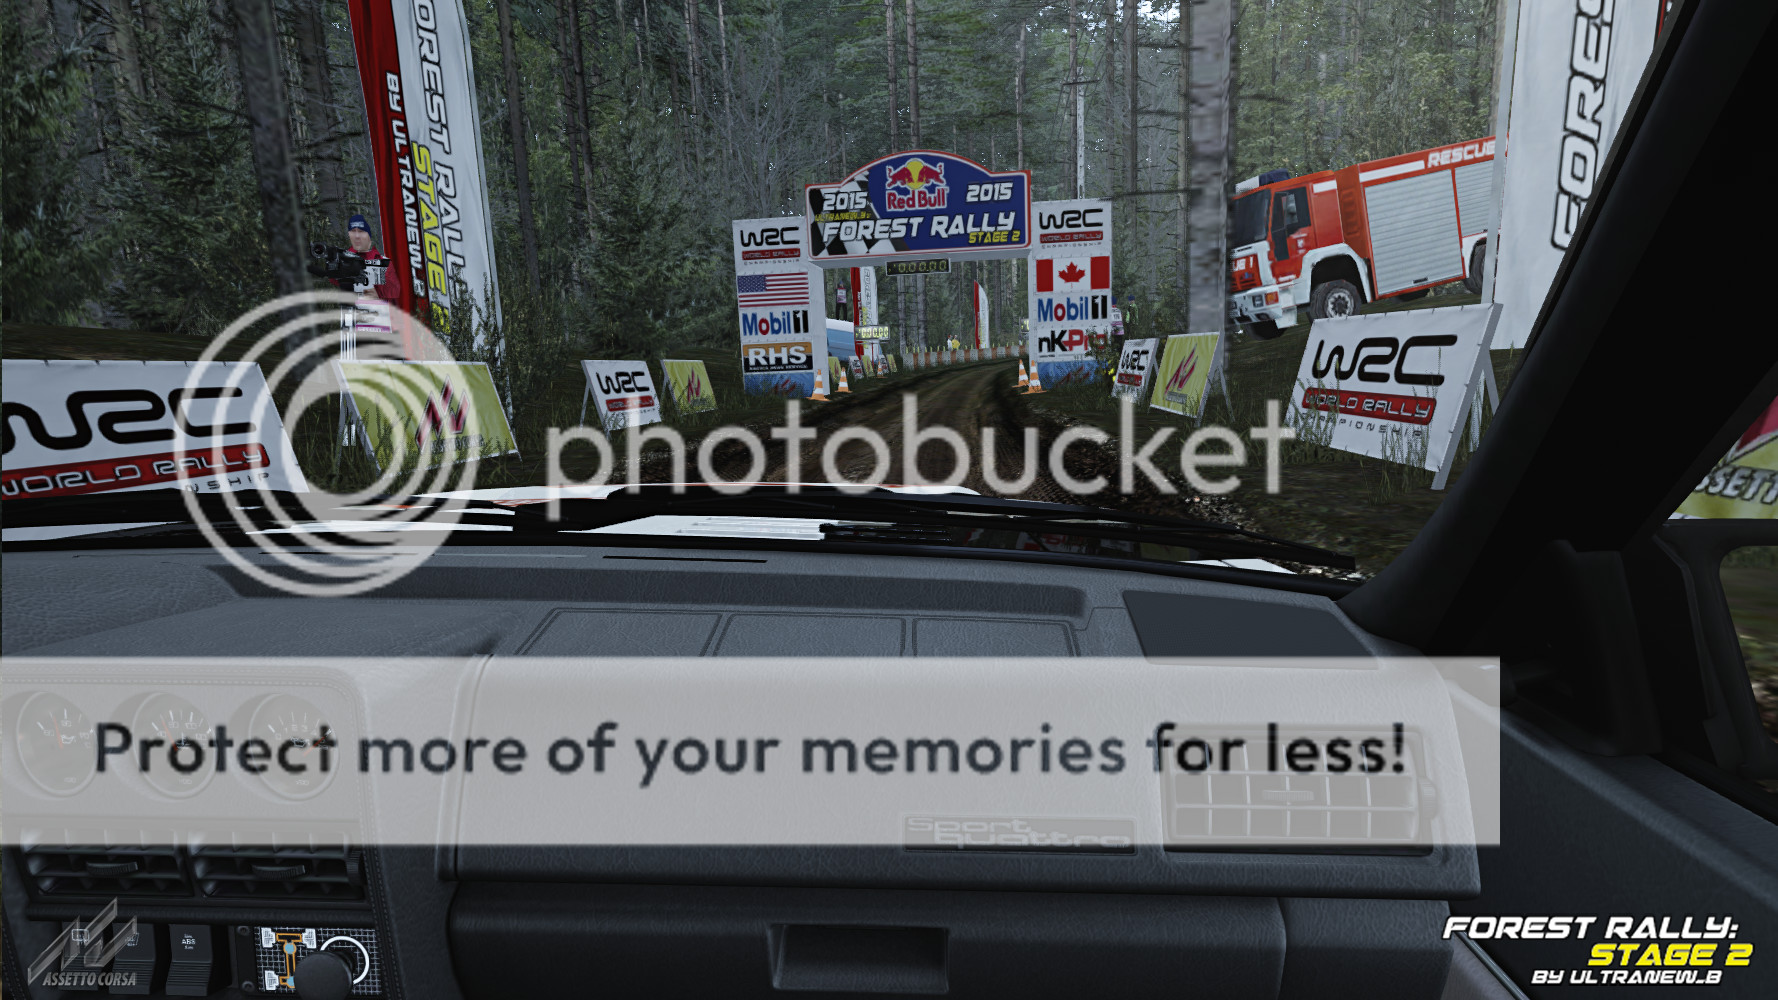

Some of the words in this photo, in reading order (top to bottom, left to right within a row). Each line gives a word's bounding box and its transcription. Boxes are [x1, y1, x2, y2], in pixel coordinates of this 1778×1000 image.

[386, 72, 402, 112] BY
[822, 191, 868, 211] 2015
[887, 191, 916, 211] Red
[917, 187, 947, 208] Bull
[966, 182, 1013, 202] 2015
[411, 141, 447, 297] STAGE
[434, 160, 469, 299] RALL
[823, 216, 924, 243] FOREST
[930, 211, 1016, 239] RALLY
[1039, 208, 1103, 230] WRC
[740, 226, 800, 247] WRC
[968, 232, 1009, 244] STAGE
[1012, 230, 1020, 242] 2
[1037, 296, 1089, 322] Mobil
[742, 311, 791, 336] Mobil
[748, 345, 807, 366] RHS
[1312, 334, 1458, 386] WRC
[595, 371, 650, 395] WRC
[1362, 399, 1431, 419] RALLY
[152, 449, 262, 476] RALLY
